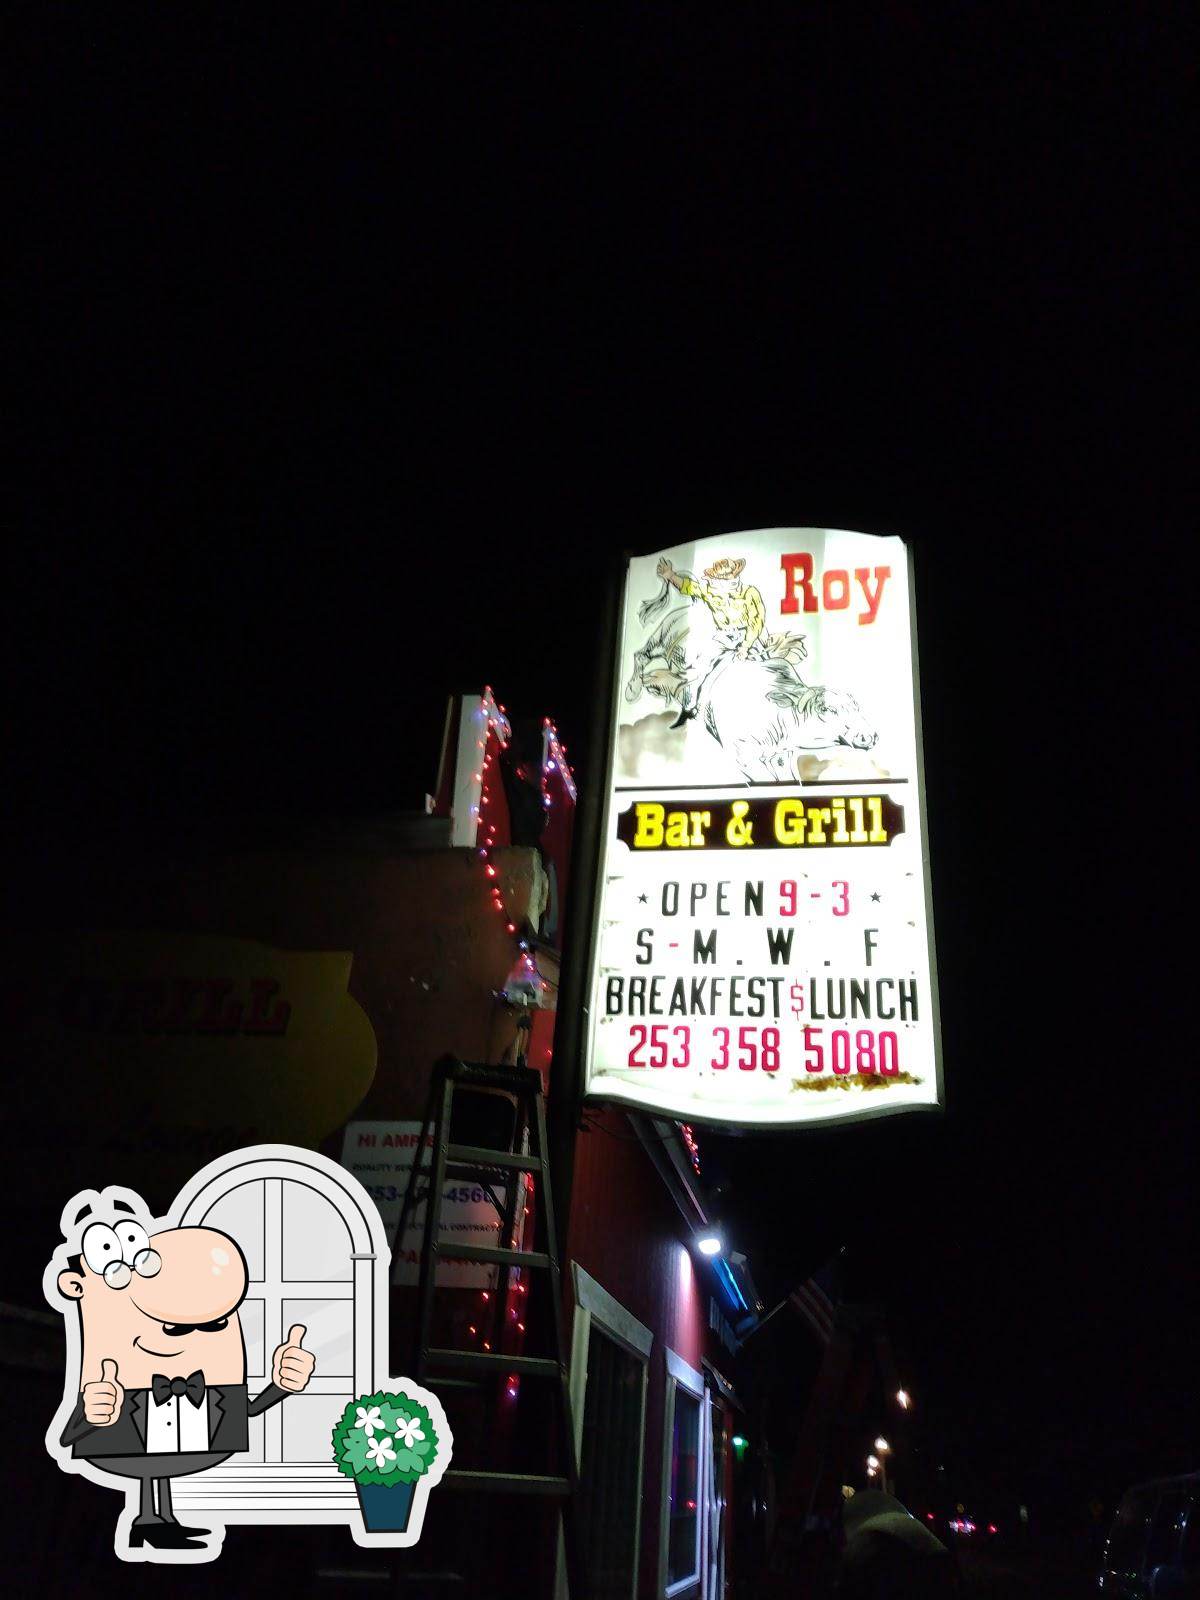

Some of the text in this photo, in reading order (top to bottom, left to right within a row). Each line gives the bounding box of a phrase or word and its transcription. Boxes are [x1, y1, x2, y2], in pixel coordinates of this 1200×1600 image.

[780, 553, 890, 624] Roy
[633, 797, 888, 848] Bar & Grill
[661, 880, 764, 917] OPEN
[606, 976, 785, 1019] BREAKFEST
[810, 978, 919, 1021] LUNCH
[628, 1025, 900, 1076] 253 358 5080
